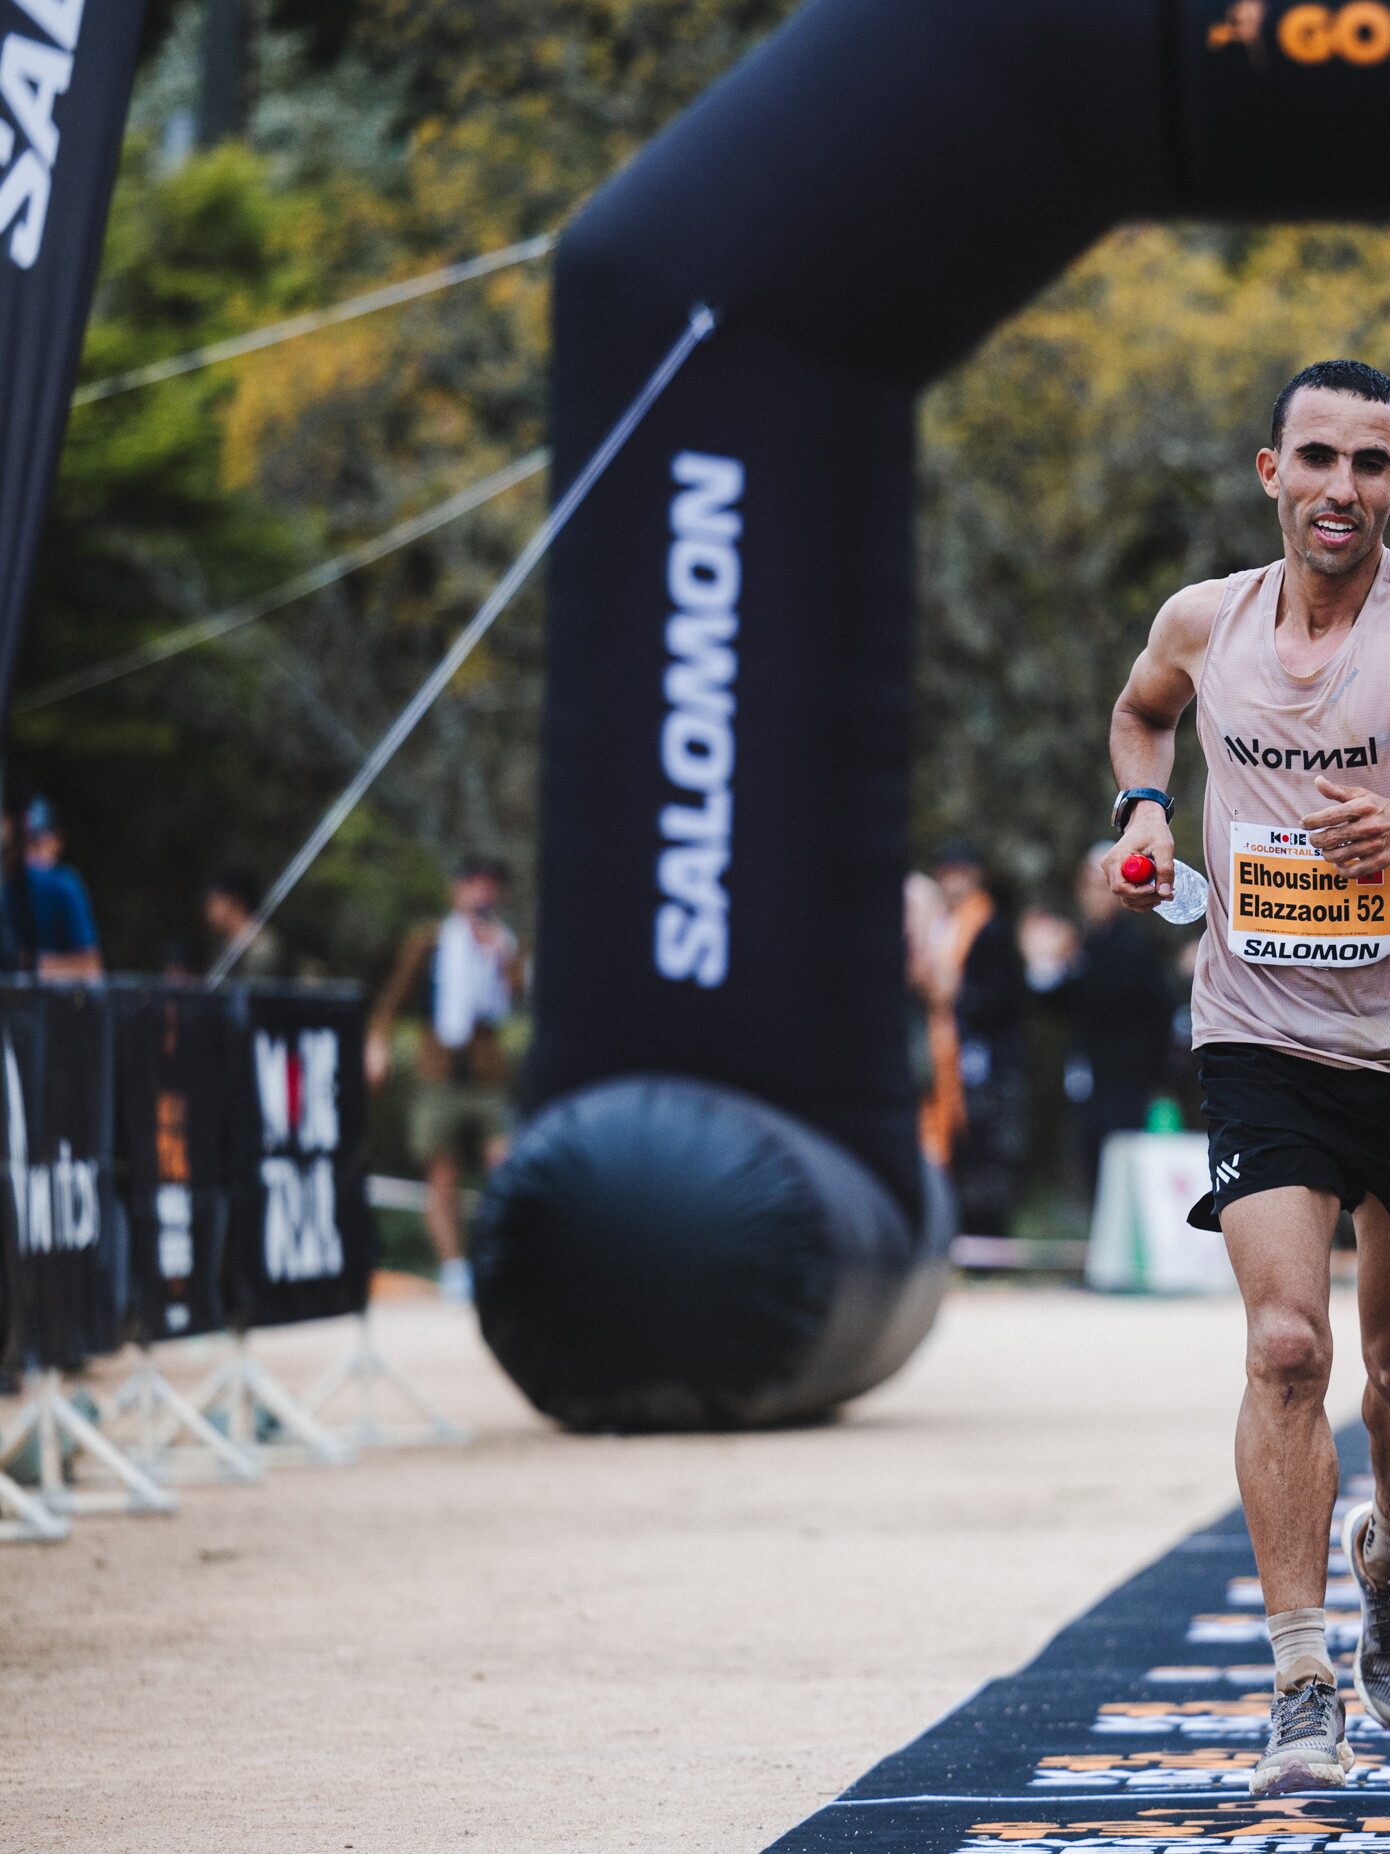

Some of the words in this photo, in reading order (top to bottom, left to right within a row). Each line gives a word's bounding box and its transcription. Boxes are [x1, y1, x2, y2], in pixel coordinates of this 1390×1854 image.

[655, 450, 745, 988] SALOMON
[1239, 861, 1348, 891] Elhousine
[1239, 893, 1350, 922] Elazzaoui
[1357, 895, 1385, 922] 52
[1243, 939, 1380, 961] SALOMON
